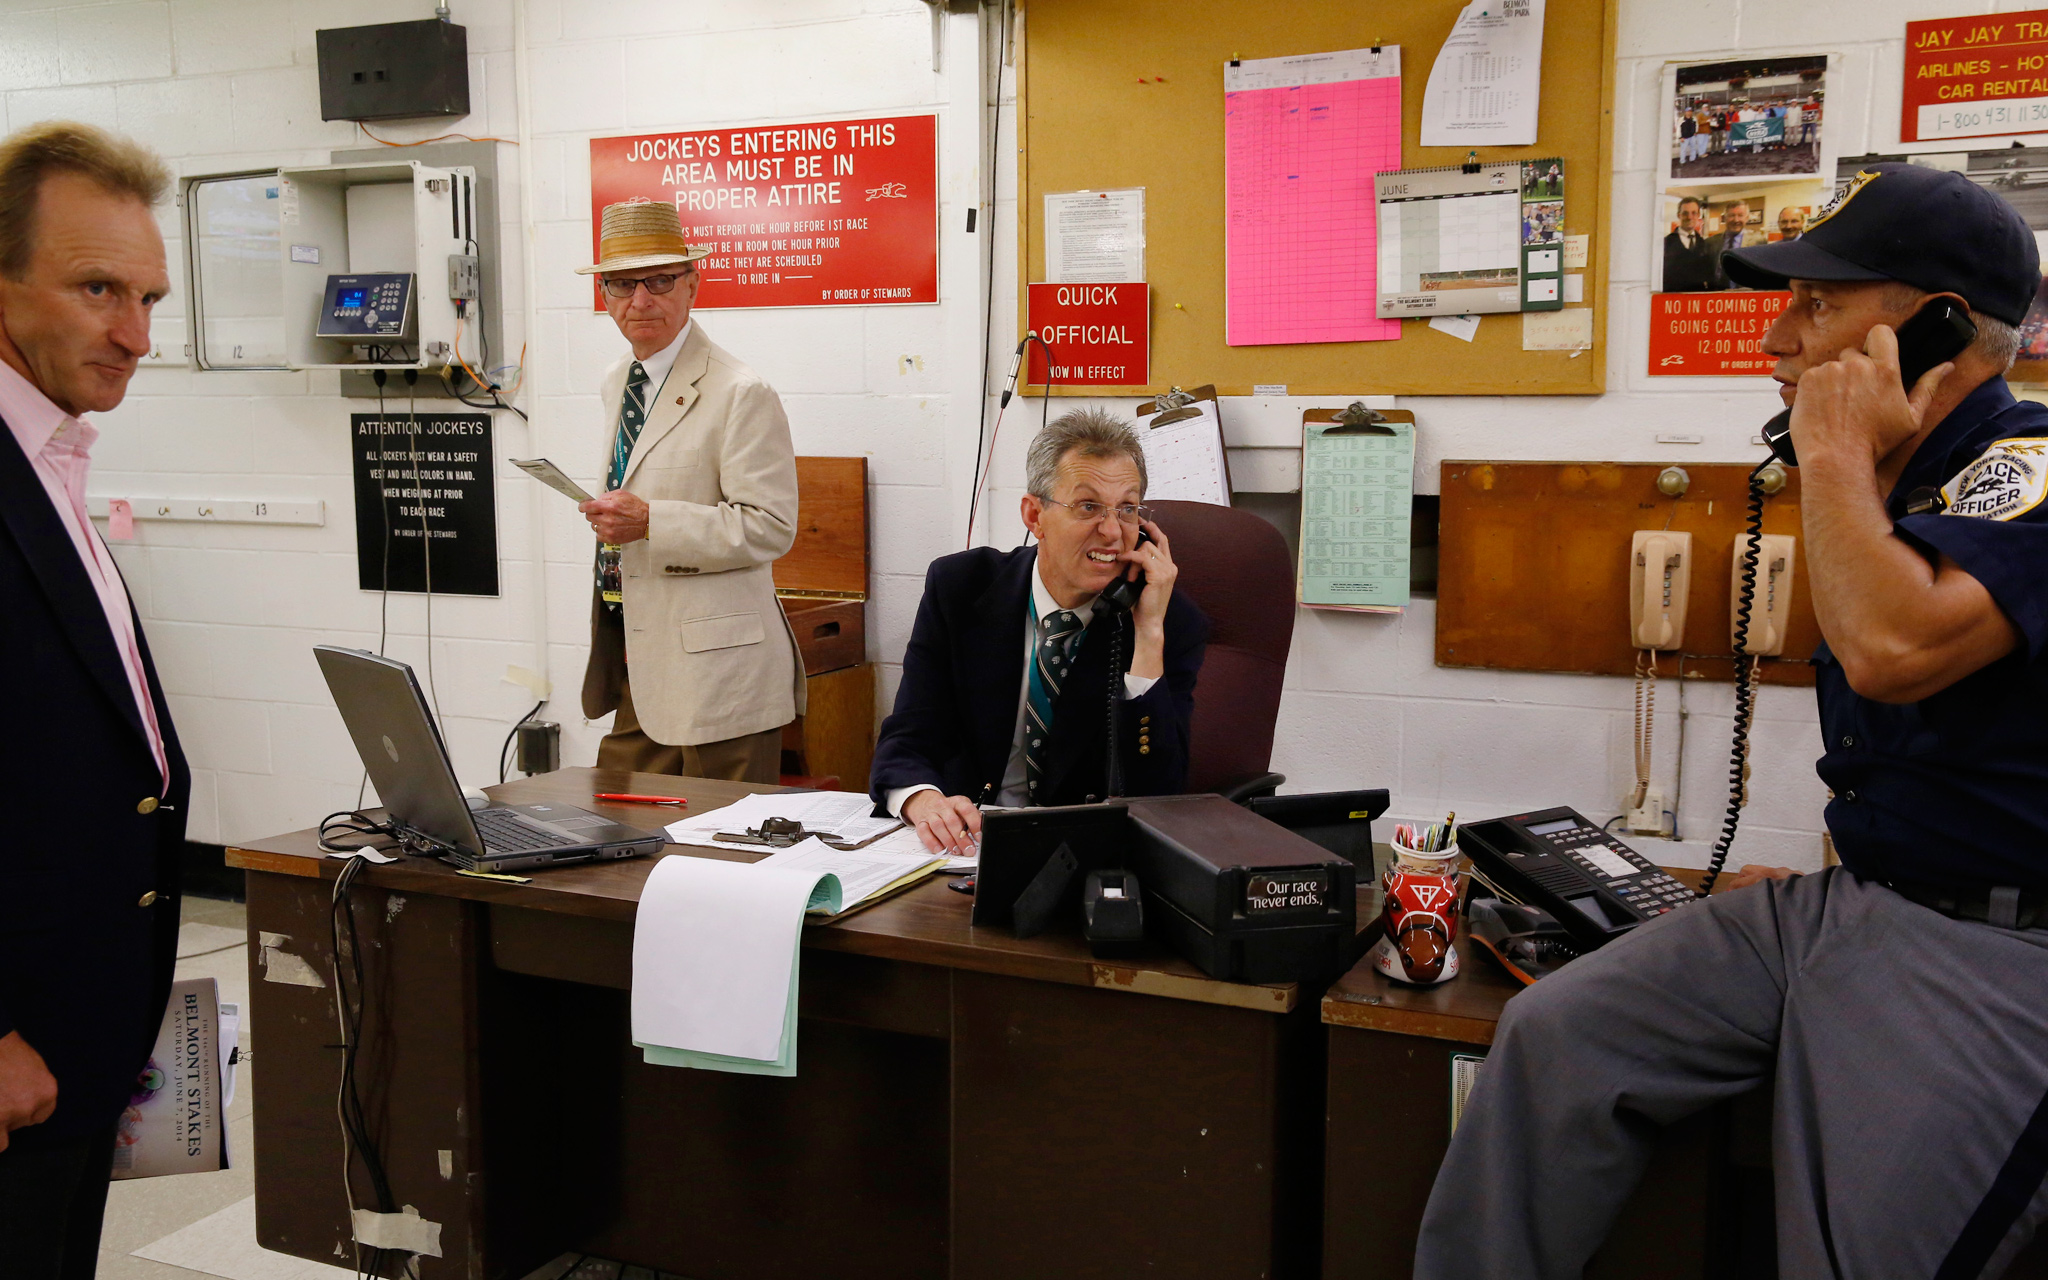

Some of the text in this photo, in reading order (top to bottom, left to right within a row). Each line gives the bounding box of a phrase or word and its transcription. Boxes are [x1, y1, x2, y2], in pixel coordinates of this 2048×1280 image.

[1514, 8, 1530, 17] PARK
[1914, 29, 1954, 48] JAY
[1963, 25, 2004, 44] JAY
[1916, 59, 1991, 79] AIRLINES
[1938, 78, 2048, 99] CAR RENTAL
[1937, 112, 1980, 131] 1-800
[1985, 106, 2011, 125] 431
[626, 123, 896, 162] JOCKEYS ENTERING THIS
[661, 153, 854, 186] AREA MUST BE IN
[675, 182, 842, 213] PROPER ATTIRE
[1381, 184, 1409, 196] JUNE
[693, 225, 714, 238] MUST
[717, 224, 747, 236] REPORT
[750, 222, 766, 235] ONE
[769, 221, 791, 234] HOUR
[794, 219, 825, 233] BEFORE
[846, 217, 868, 230] RACE
[721, 241, 731, 253] BE
[735, 241, 743, 252] IN
[746, 240, 768, 252] ROOM
[771, 239, 787, 251] ONE
[791, 238, 812, 250] HOUR
[816, 237, 840, 249] PRIOR
[710, 257, 730, 269] RACE
[733, 256, 753, 268] THEY
[756, 256, 772, 268] ARE
[775, 254, 822, 267] SCHEDULED
[737, 272, 780, 285] TO RIDE IN
[822, 287, 912, 300] BY ORDER OF STEWARDS
[1057, 286, 1118, 306] QUICK
[1665, 300, 1681, 314] NO
[1687, 299, 1700, 314] IN
[1706, 298, 1757, 314] COMING
[1763, 298, 1781, 313] OR
[1670, 320, 1709, 334] GOING
[1715, 318, 1756, 333] CALLS
[1042, 325, 1133, 344] OFFICIAL
[233, 345, 243, 359] 12
[1698, 339, 1763, 354] 12:00 NOO
[1049, 366, 1126, 379] NOW IN EFFECT
[1720, 360, 1729, 369] BY
[1731, 360, 1753, 369] ORDER
[1755, 360, 1764, 369] OF
[358, 421, 484, 435] ATTENTION JOCKEYS
[366, 451, 378, 461] ALL
[380, 451, 407, 461] OCKEYS
[427, 452, 446, 462] WEAR
[447, 452, 452, 462] A
[453, 452, 478, 462] SAFETY
[369, 469, 385, 479] VEST
[387, 469, 400, 479] AND
[420, 470, 445, 480] COLORS
[446, 470, 454, 480] IN
[455, 471, 476, 481] HAND.
[1957, 454, 2033, 496] NEW YORK RACING
[383, 488, 400, 498] WHEN
[433, 489, 442, 499] AT
[443, 489, 464, 499] PRIOR
[1951, 488, 2021, 514] OFFICER
[255, 503, 267, 516] 13
[400, 506, 408, 516] TO
[428, 507, 446, 518] RACE
[394, 528, 400, 537] BY
[401, 529, 416, 537] ORDER
[433, 530, 457, 539] STEWARDS
[1266, 881, 1317, 895] Our race
[1253, 892, 1319, 909] never ends.
[174, 1010, 184, 1072] SATURDAY,
[184, 993, 201, 1157] BELMONT STAKES
[175, 1076, 184, 1104] JUNE
[204, 1100, 210, 1109] OF
[175, 1119, 183, 1142] 2014
